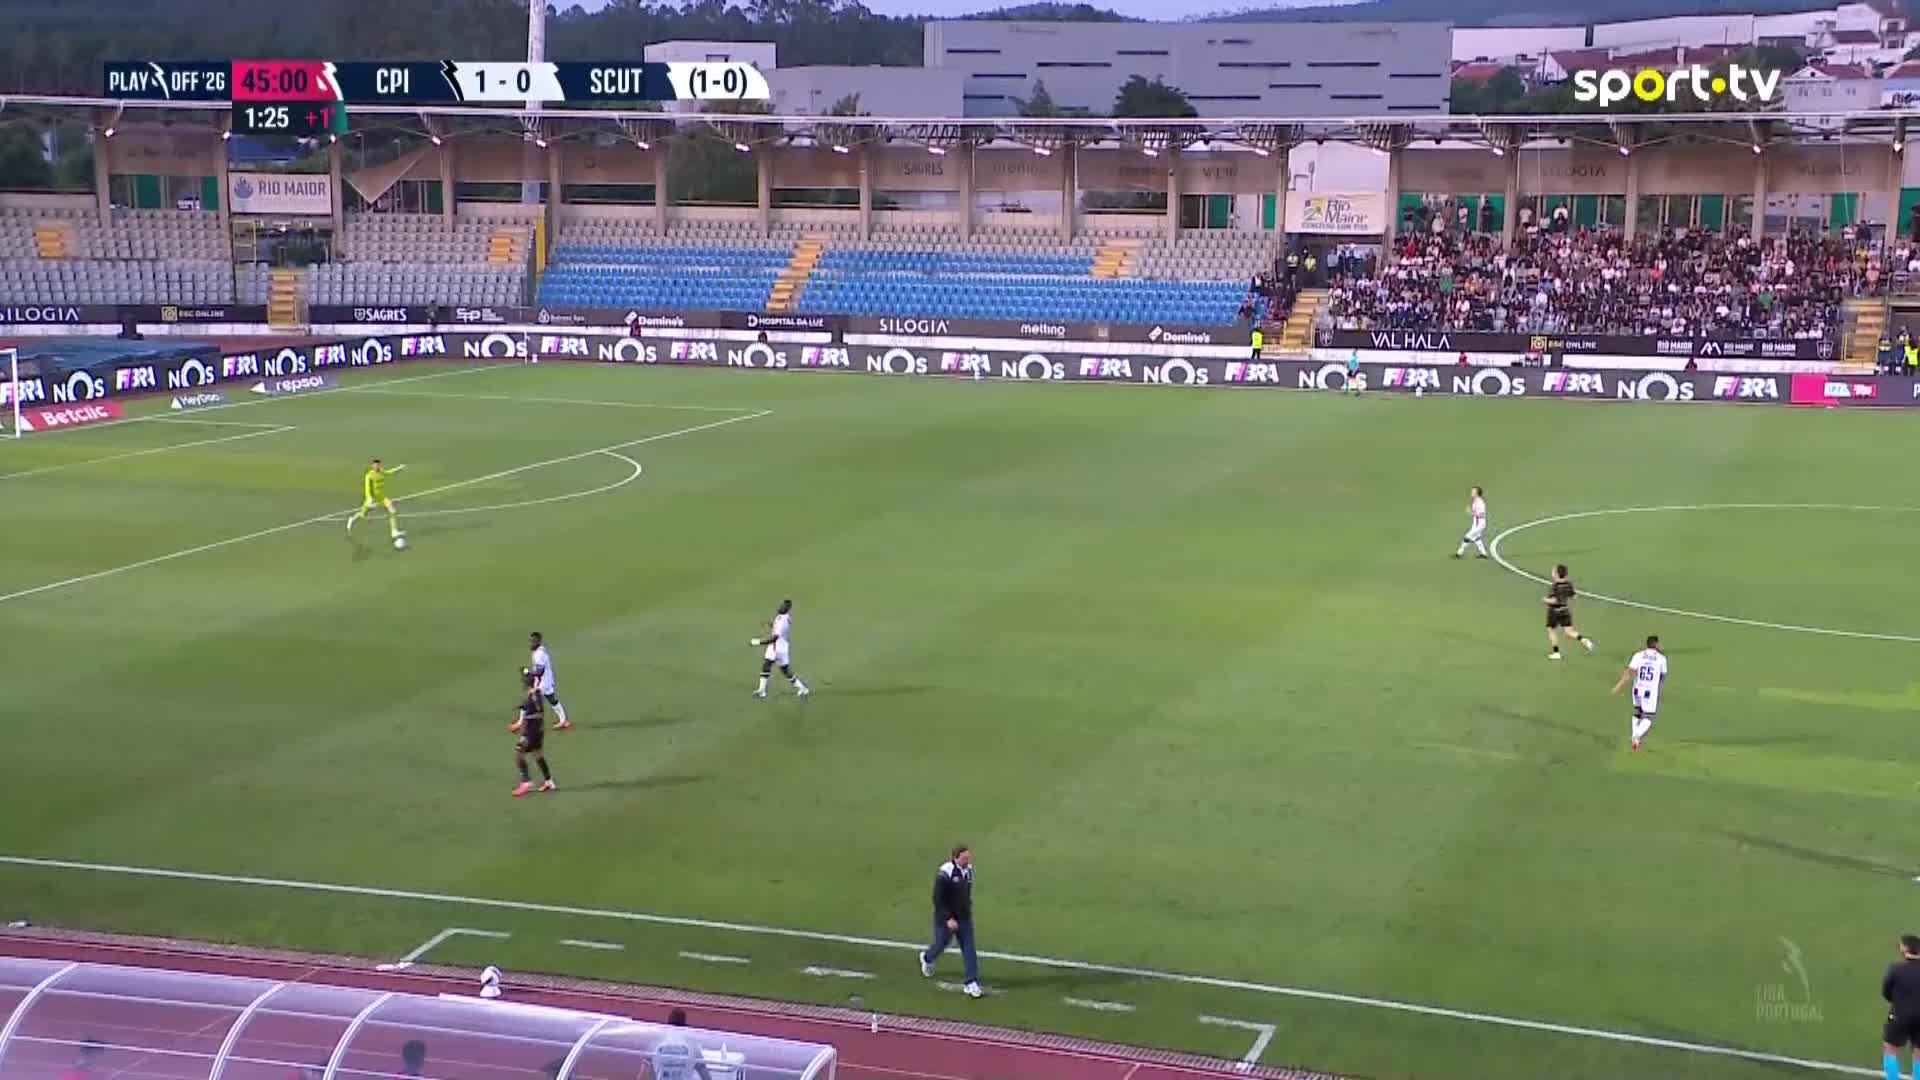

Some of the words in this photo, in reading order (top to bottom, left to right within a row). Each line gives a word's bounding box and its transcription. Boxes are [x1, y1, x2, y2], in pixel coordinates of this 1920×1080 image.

[258, 180, 280, 196] RIO
[284, 181, 326, 196] MAIOR
[1327, 200, 1351, 212] Rio
[1325, 210, 1369, 224] Maior
[366, 308, 407, 321] SAGRES
[638, 316, 684, 328] Domino's
[759, 317, 796, 326] HOSPITAL
[796, 318, 808, 326] DA
[880, 319, 948, 333] SILOGIA
[401, 335, 446, 356] FIBRA
[464, 333, 528, 358] NOS
[541, 336, 590, 356] FIBRA
[1163, 332, 1211, 343] Domino's
[314, 344, 347, 366] FIBRA
[351, 338, 392, 366] NOS
[598, 337, 657, 362] NOS
[670, 341, 718, 361] FIBRA
[728, 342, 787, 368] NOS
[801, 346, 850, 367] FIBRA
[223, 354, 259, 378] FIBRA
[264, 348, 307, 377] NOS
[867, 348, 928, 374] NOS
[941, 352, 991, 373] FIBRA
[1002, 354, 1065, 380] NOS
[1080, 358, 1133, 377] FIBRA
[1143, 358, 1209, 384] NOS
[116, 366, 156, 390] FIBRA
[168, 359, 215, 389] NOS
[1225, 362, 1279, 383] FIBRA
[1382, 368, 1440, 388] FIBRA
[1453, 368, 1526, 396] NOS
[1543, 372, 1604, 393] FIBRA
[53, 371, 105, 402] NOS
[276, 376, 323, 393] repsol
[1617, 371, 1694, 401] NOS
[1713, 376, 1779, 398] FIBRA
[41, 406, 109, 426] Betclic
[1639, 666, 1654, 681] 65
